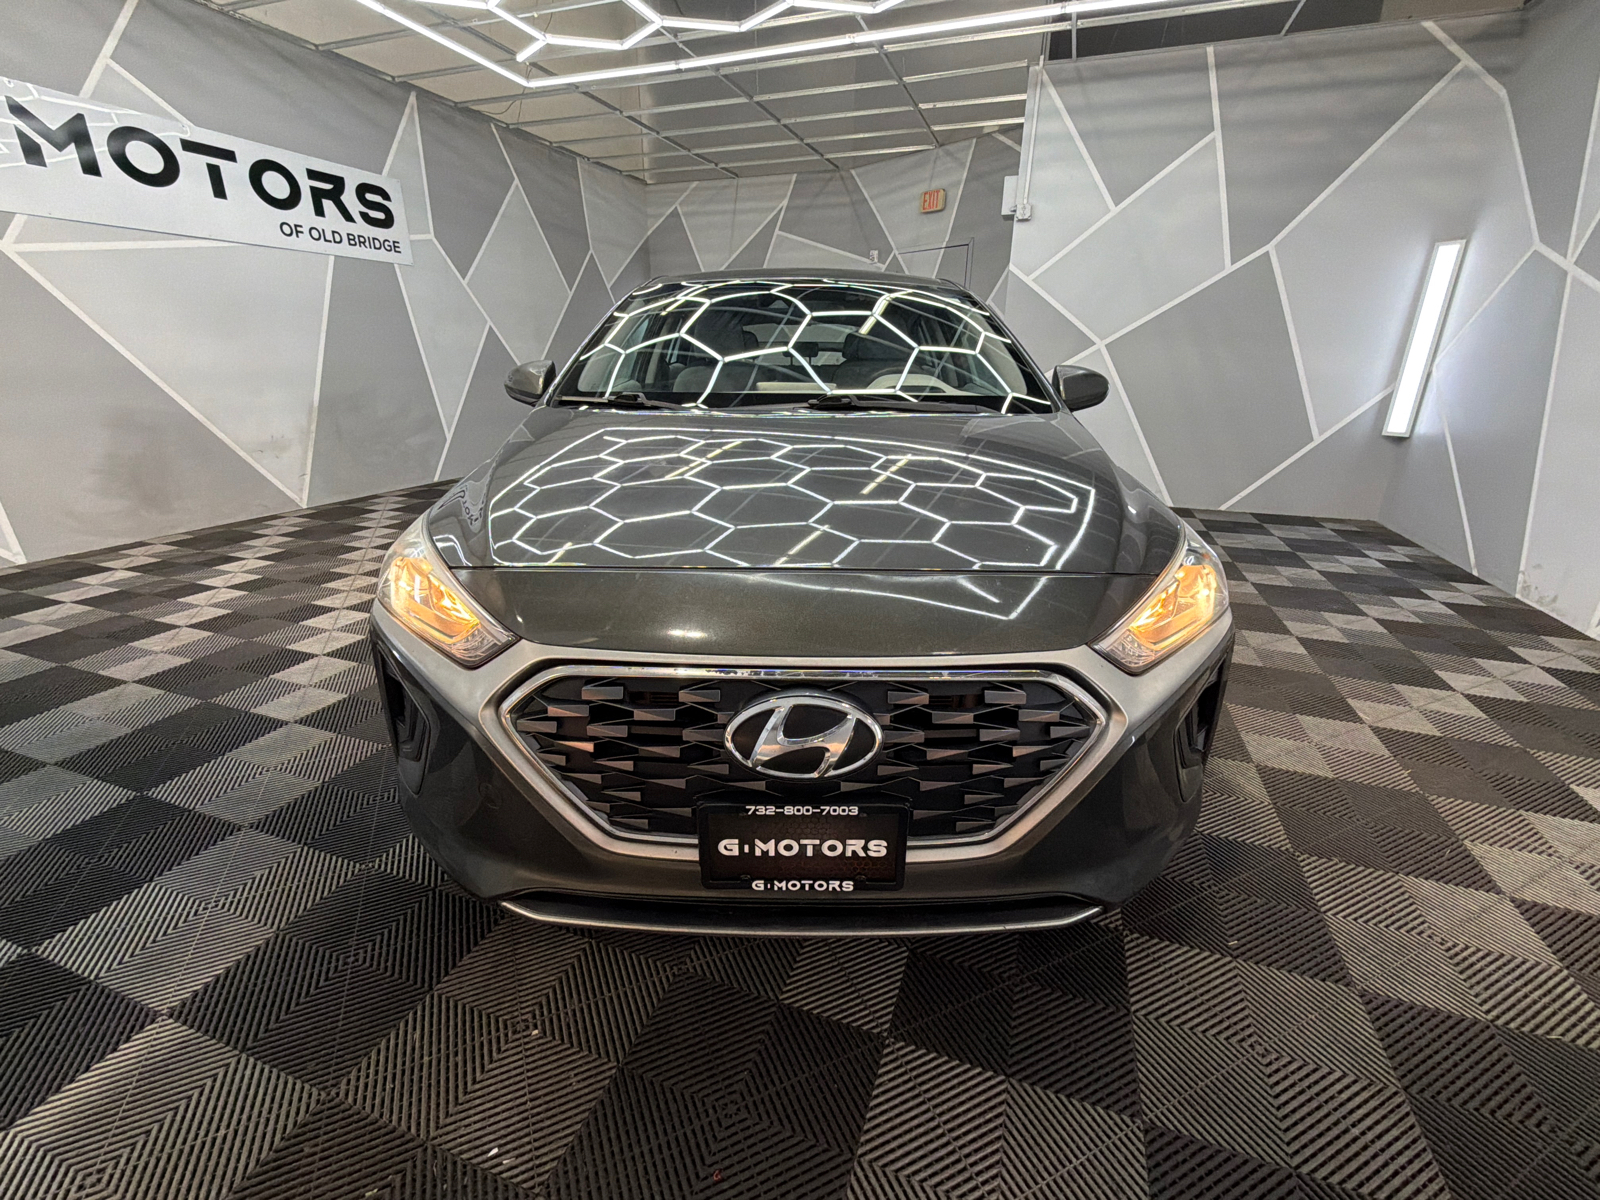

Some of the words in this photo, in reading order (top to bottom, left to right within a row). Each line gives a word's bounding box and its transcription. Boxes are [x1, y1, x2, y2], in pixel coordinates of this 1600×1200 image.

[4, 95, 395, 229] MOTORS
[922, 189, 940, 211] EXIT
[279, 221, 304, 238] OF
[309, 226, 343, 244] OLD
[346, 232, 402, 254] BRIDGE
[746, 806, 859, 816] 732-800-7003
